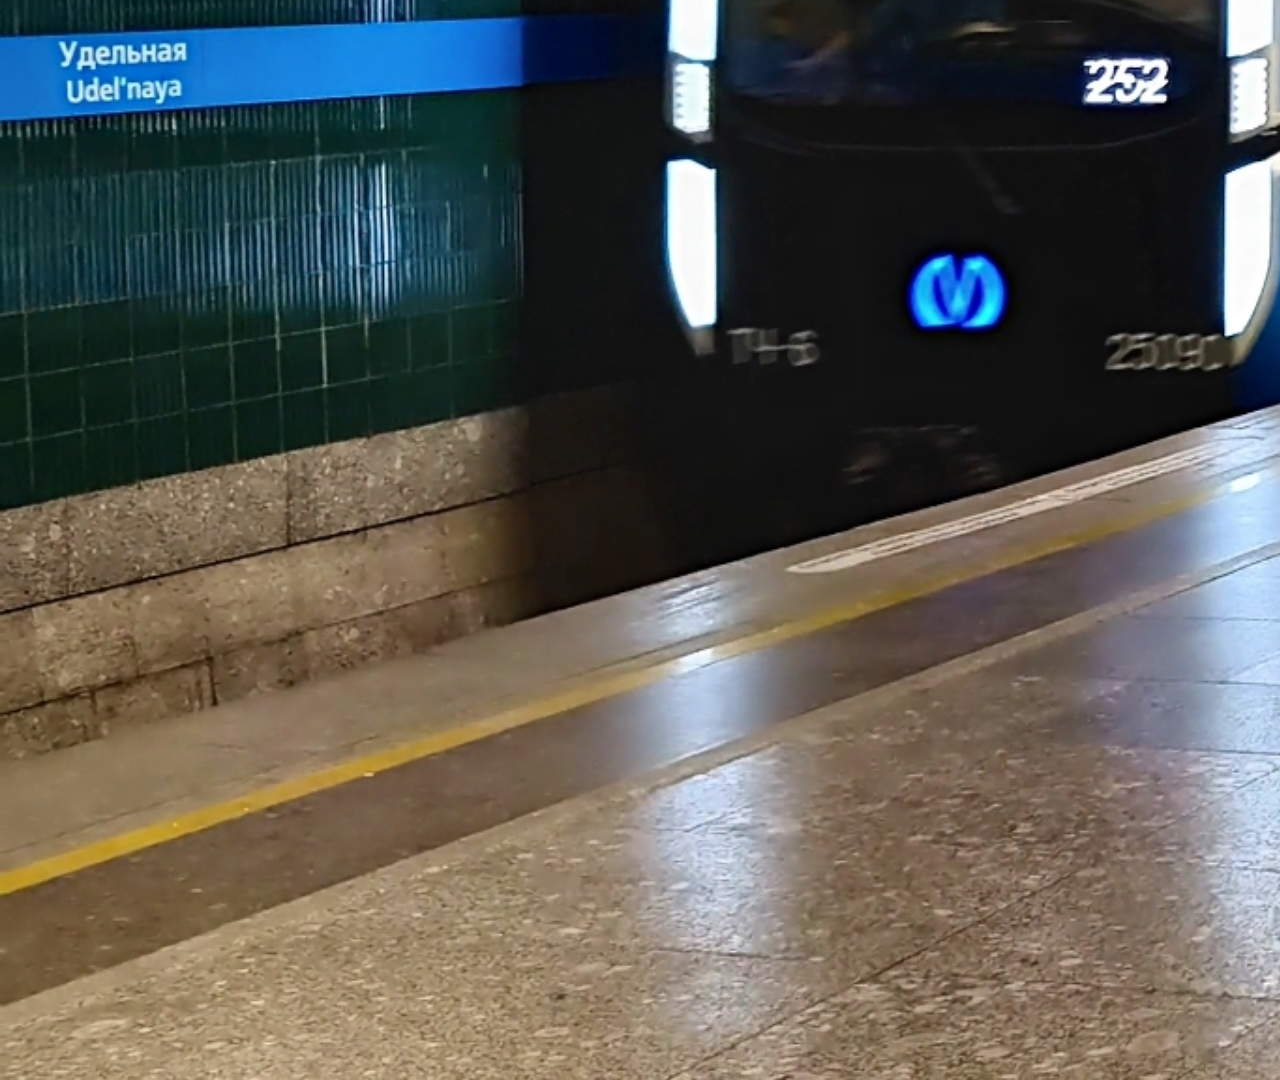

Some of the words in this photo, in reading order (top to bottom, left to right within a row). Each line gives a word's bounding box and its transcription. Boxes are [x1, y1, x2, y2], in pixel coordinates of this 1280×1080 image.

[59, 41, 187, 69] Удельная
[66, 77, 182, 104] Udel'naya
[1083, 57, 1169, 104] 252
